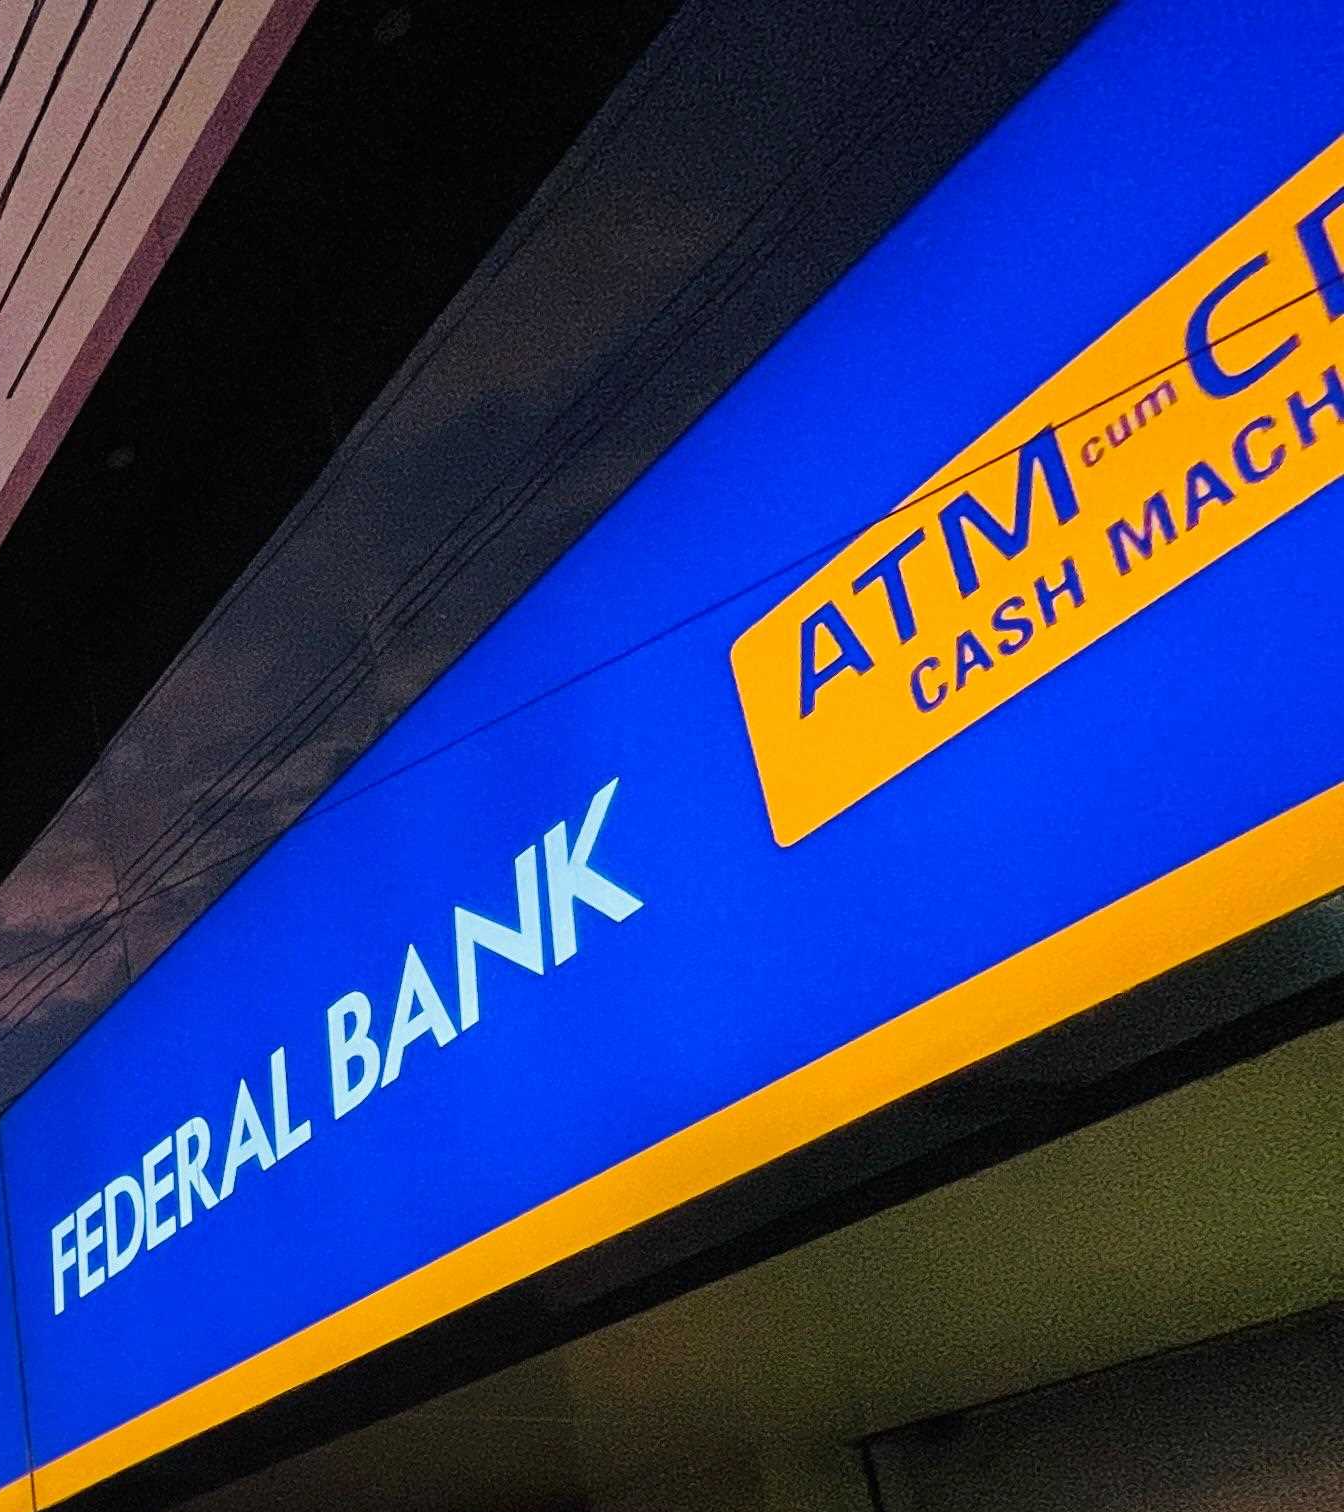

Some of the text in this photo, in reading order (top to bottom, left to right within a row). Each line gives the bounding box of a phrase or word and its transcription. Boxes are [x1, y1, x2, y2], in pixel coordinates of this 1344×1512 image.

[800, 424, 1080, 719] ATM
[1080, 379, 1179, 468] cum
[910, 556, 1088, 714] CASH
[51, 777, 644, 1315] FEDERAL BANK
